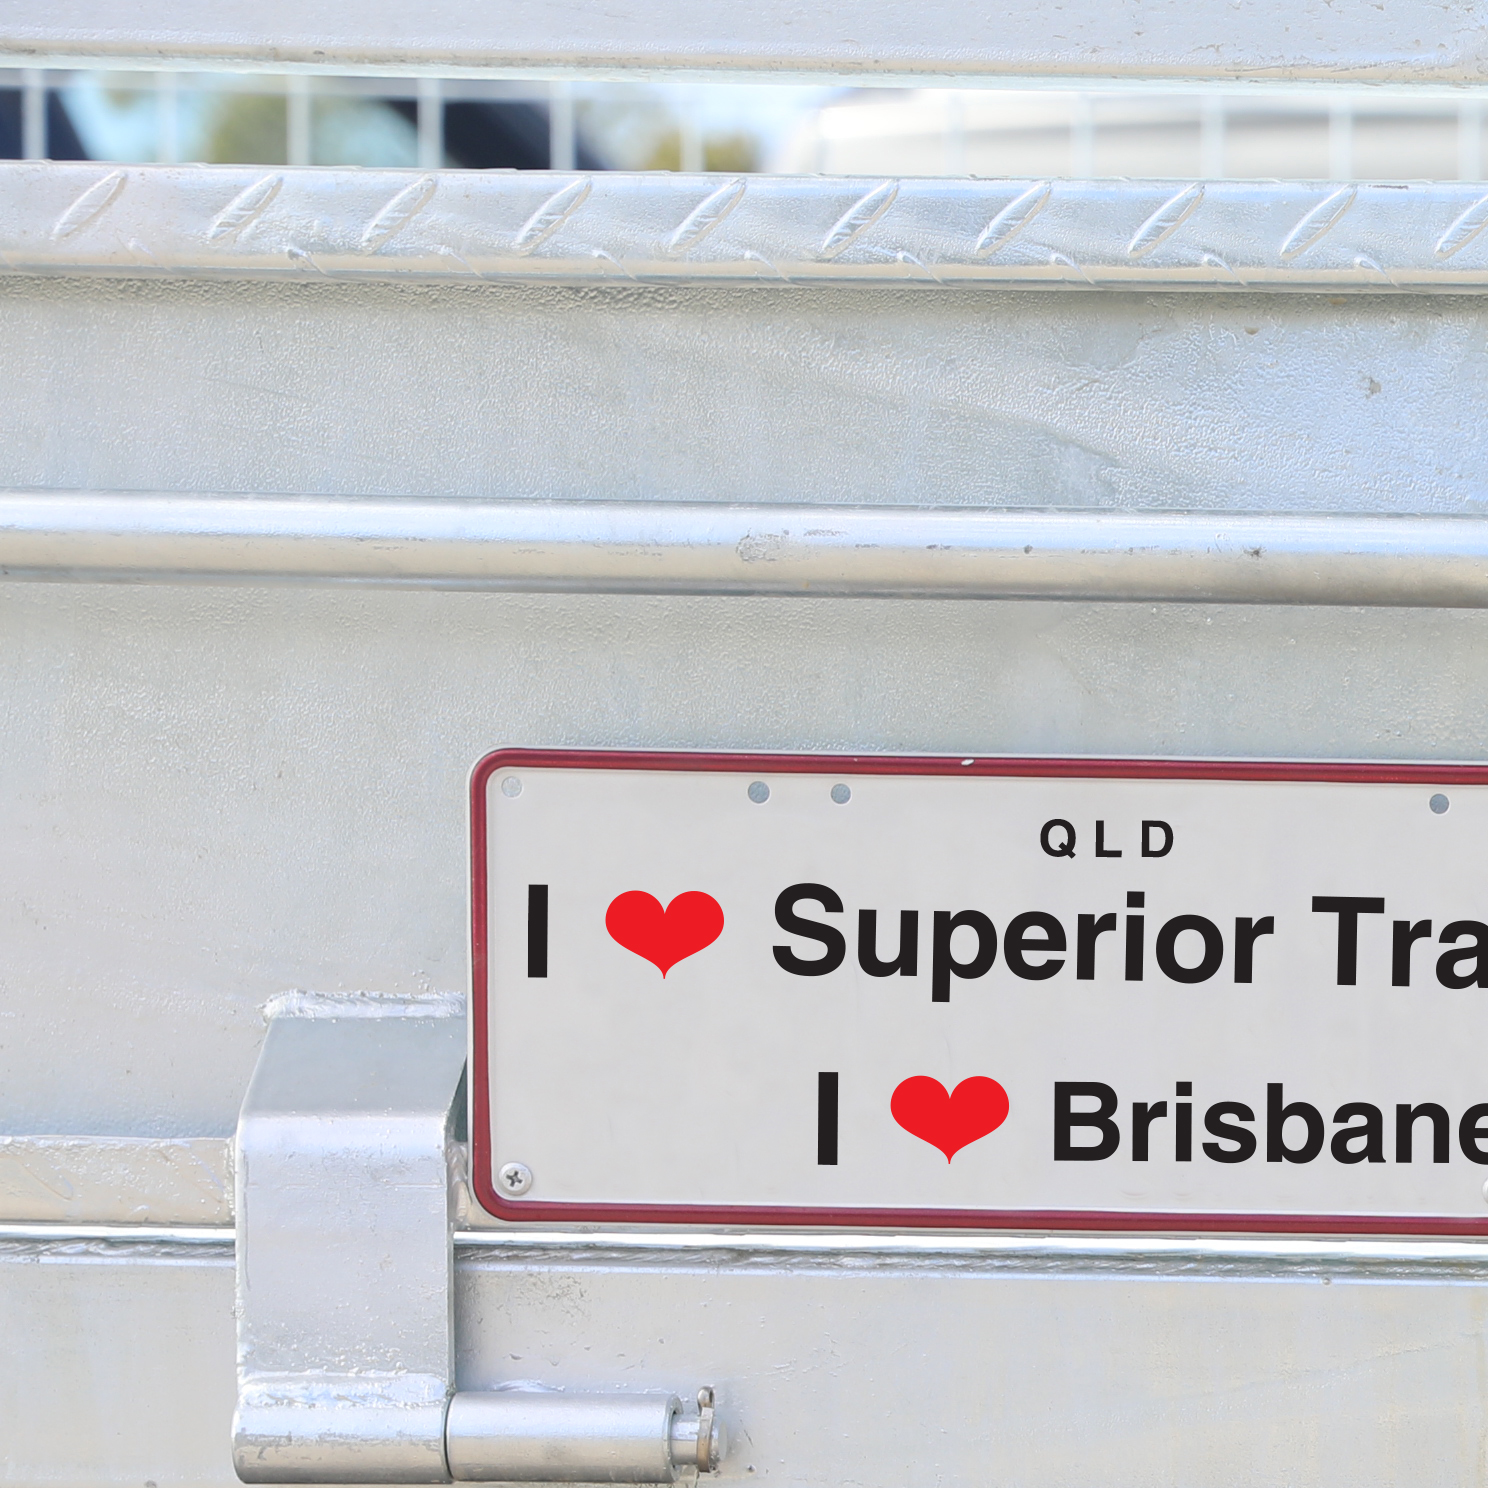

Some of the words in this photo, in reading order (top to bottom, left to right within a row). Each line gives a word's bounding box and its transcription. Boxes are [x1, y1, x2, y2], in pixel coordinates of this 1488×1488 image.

[1040, 818, 1174, 859] QLD
[527, 884, 549, 979] I
[772, 882, 1275, 1003] Superior
[817, 1071, 839, 1166] I
